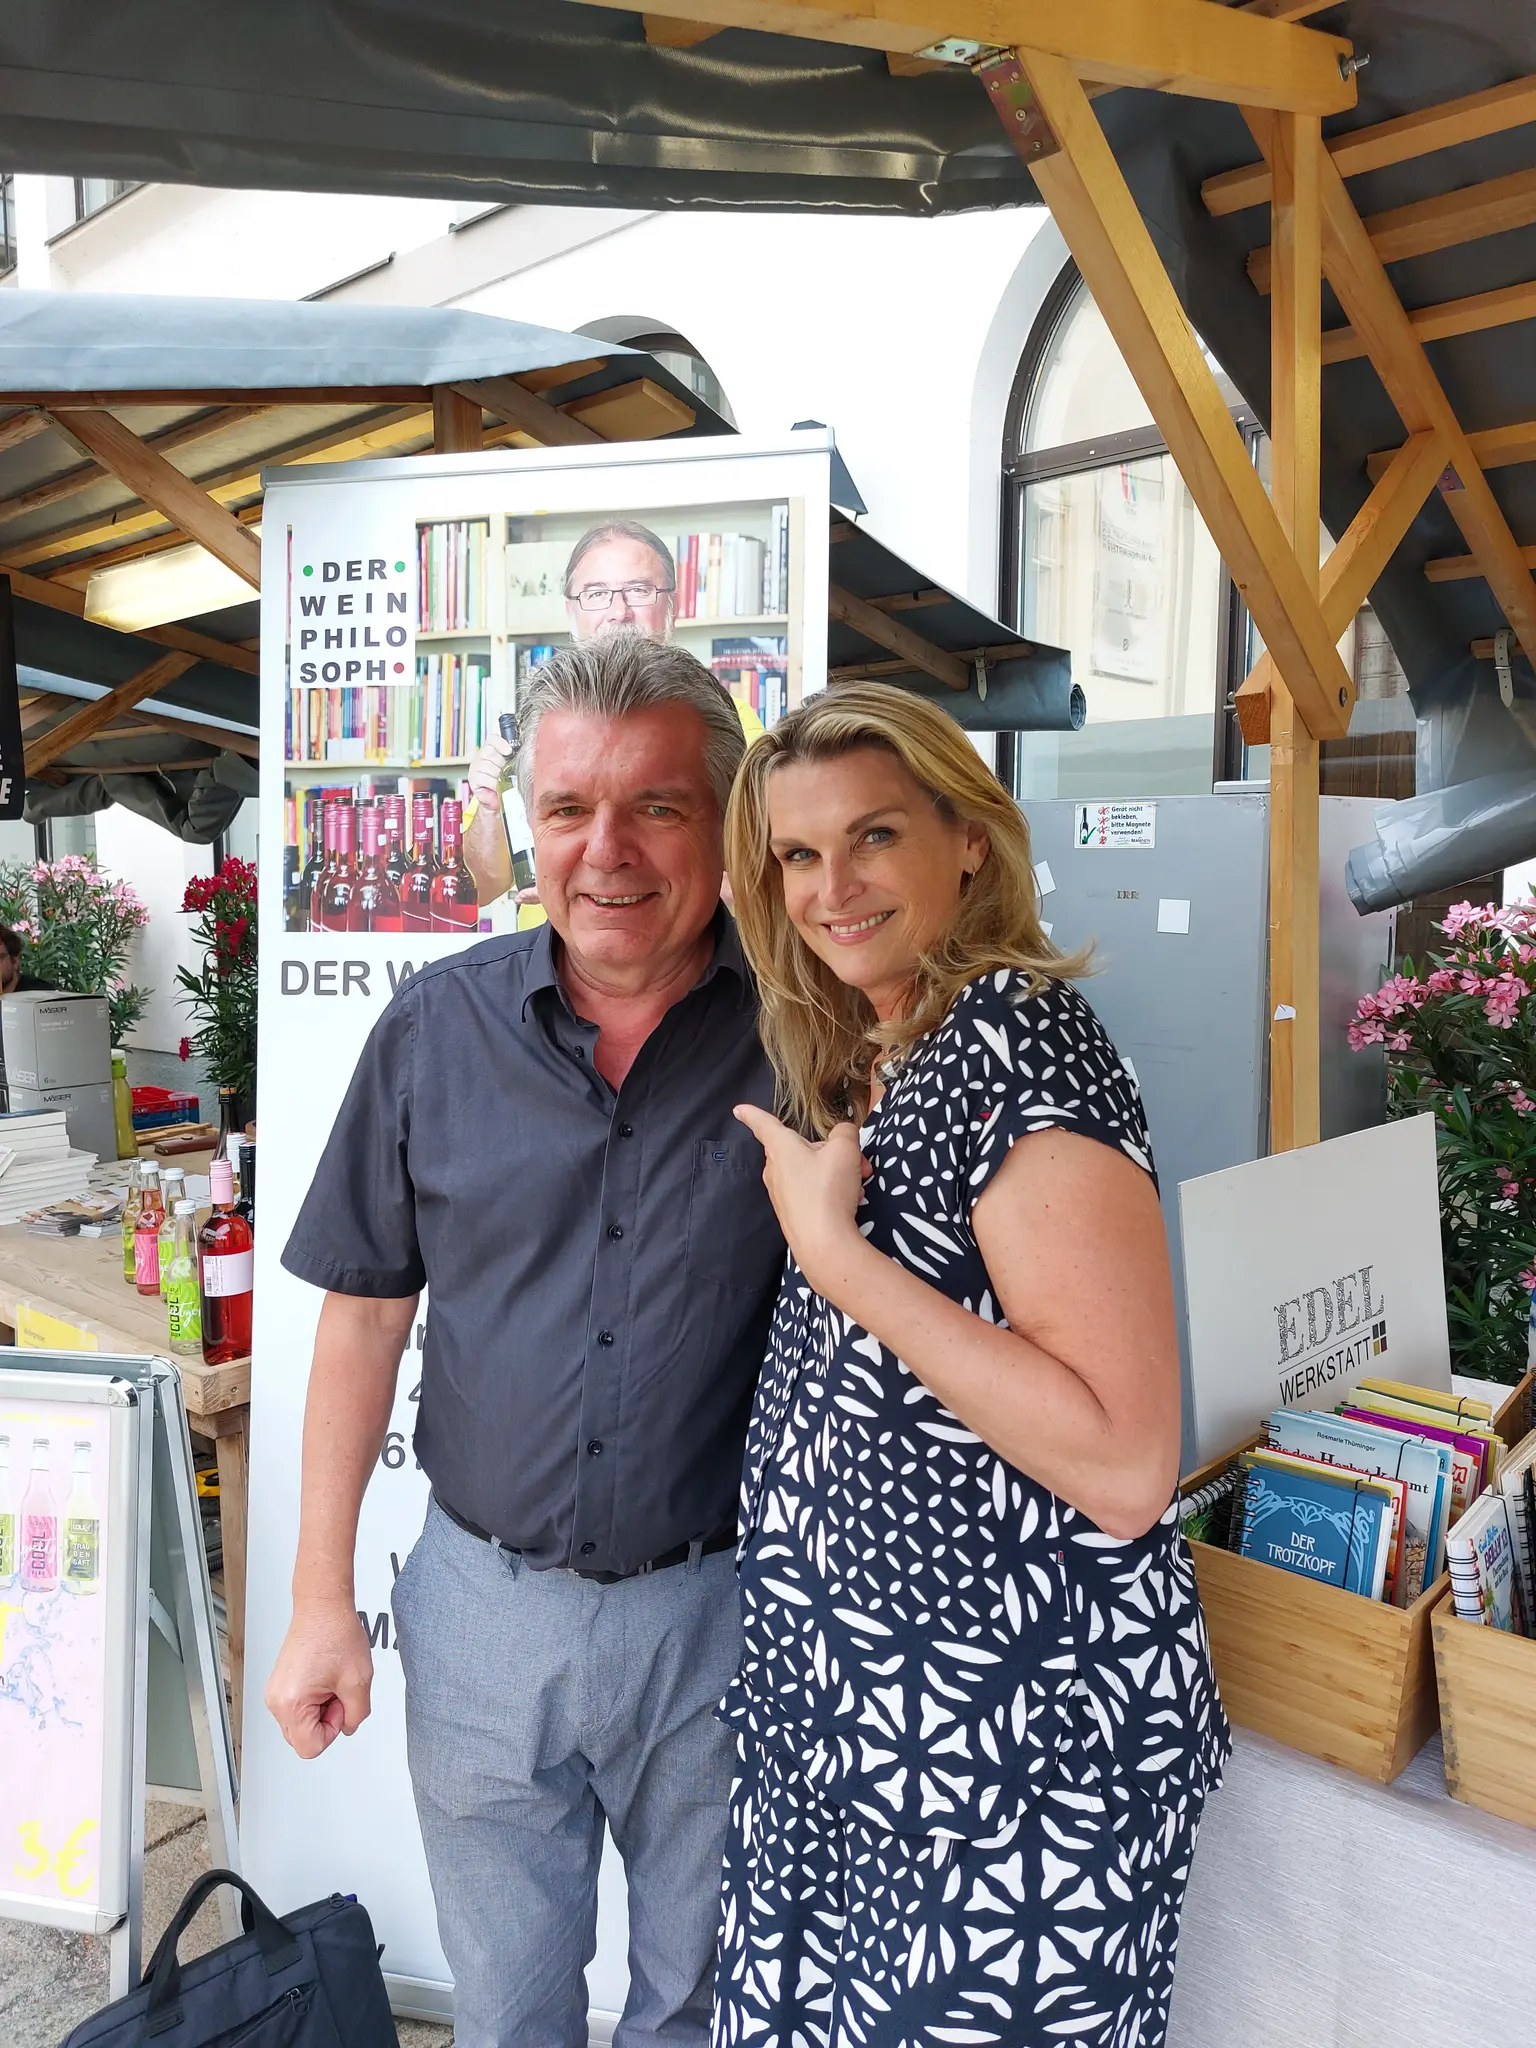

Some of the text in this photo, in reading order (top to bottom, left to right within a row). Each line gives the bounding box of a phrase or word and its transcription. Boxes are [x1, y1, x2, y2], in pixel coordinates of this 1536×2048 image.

[322, 559, 388, 583] DER
[299, 592, 407, 617] WEIN
[300, 626, 407, 650] PHILO
[299, 659, 386, 683] SOPH
[1126, 821, 1151, 829] Magnete
[281, 960, 371, 996] DER
[1274, 1264, 1385, 1365] EDEL
[1279, 1336, 1371, 1406] WERKSTATT
[1316, 1431, 1376, 1452] Rosmarie Thüminger
[1290, 1531, 1316, 1552] DER
[72, 1558, 91, 1566] SAFT
[1266, 1542, 1337, 1576] TROTZKOPF
